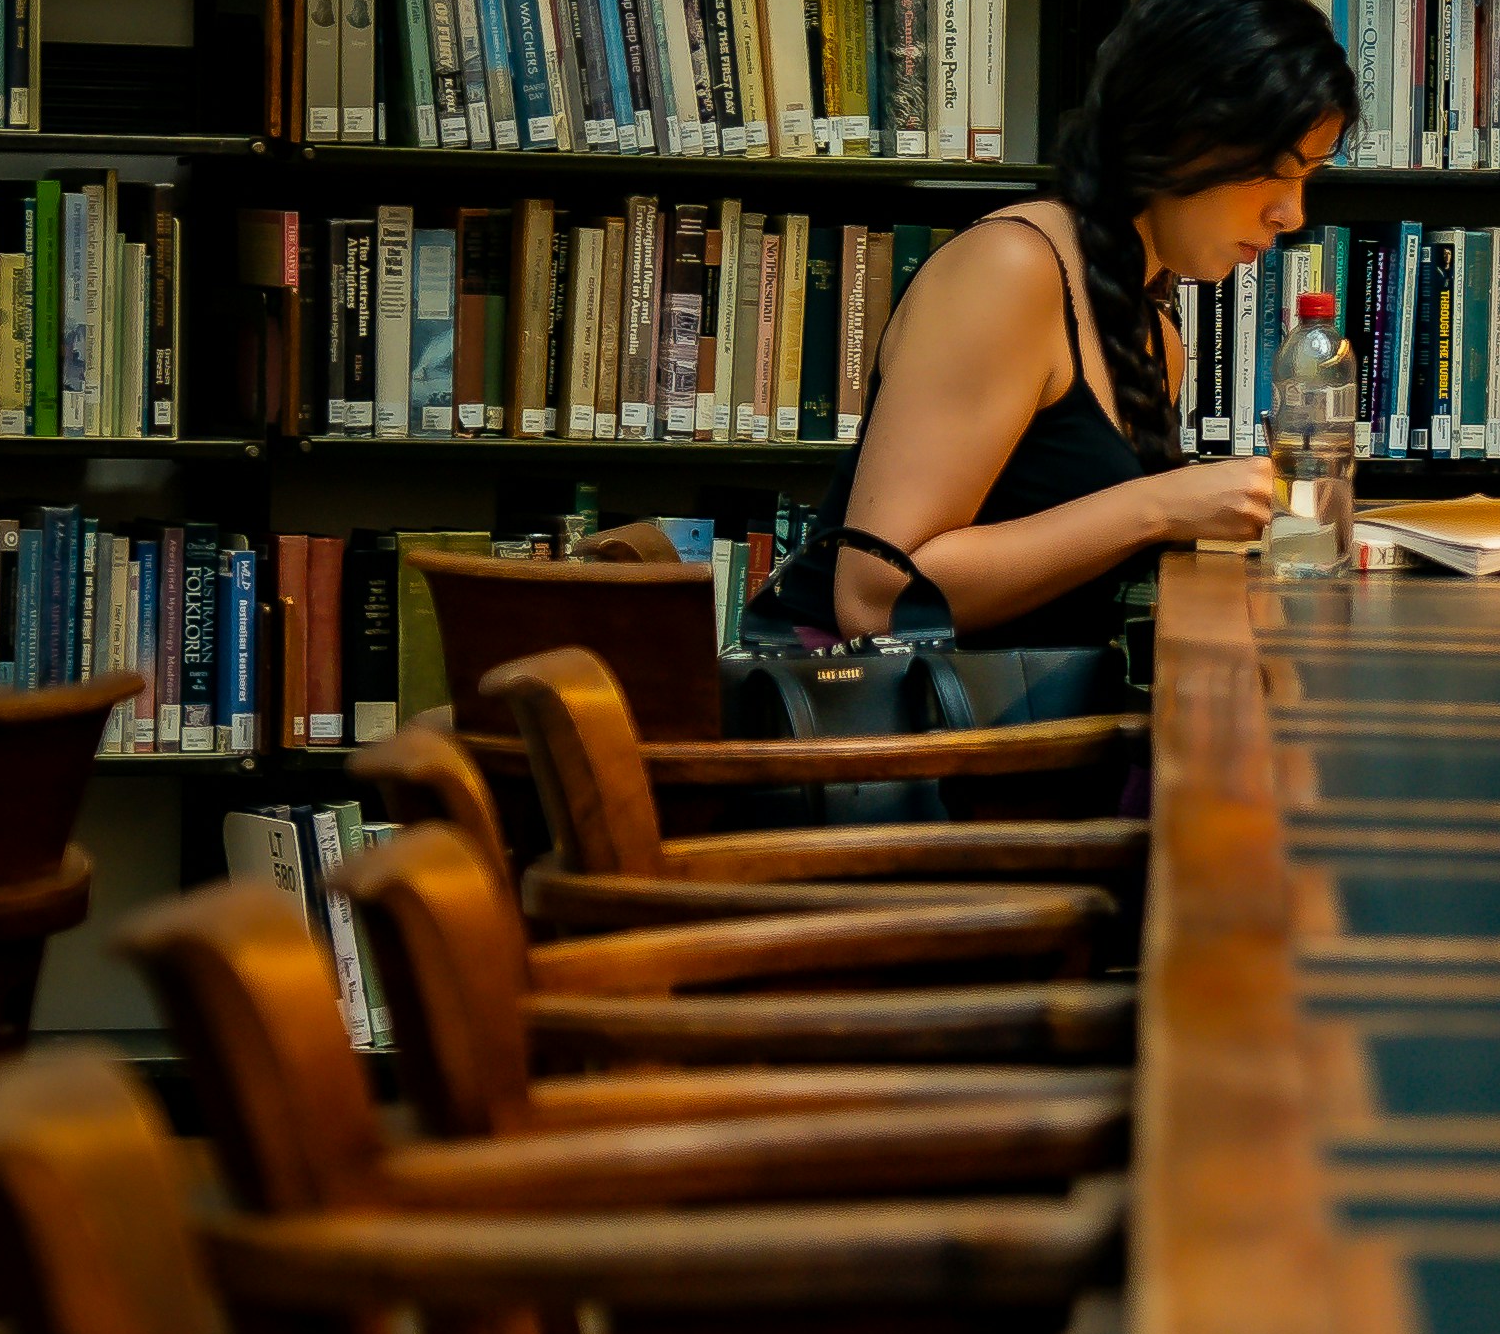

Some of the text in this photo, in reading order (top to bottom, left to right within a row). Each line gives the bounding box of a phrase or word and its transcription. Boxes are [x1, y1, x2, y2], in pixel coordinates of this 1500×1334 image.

[622, 12, 637, 42] deep
[715, 11, 726, 27] OF
[945, 19, 958, 34] of
[518, 1, 539, 75] WATCHERS
[719, 30, 729, 54] THE
[945, 36, 957, 59] the
[628, 45, 642, 73] time
[720, 56, 731, 89] FIRST
[943, 62, 958, 109] Pacific
[723, 92, 735, 115] DAY
[630, 204, 645, 285] Environment
[345, 237, 358, 309] Aborigines
[640, 205, 656, 323] Aboriginal Man and
[357, 236, 370, 337] The Australian
[628, 300, 640, 355] Australia
[1439, 290, 1450, 337] THROUGH
[1439, 339, 1449, 358] THE
[184, 566, 201, 664] FOLKLORE
[200, 566, 214, 663] AUSTRALIAN
[267, 829, 283, 857] LT
[273, 861, 297, 890] 580
